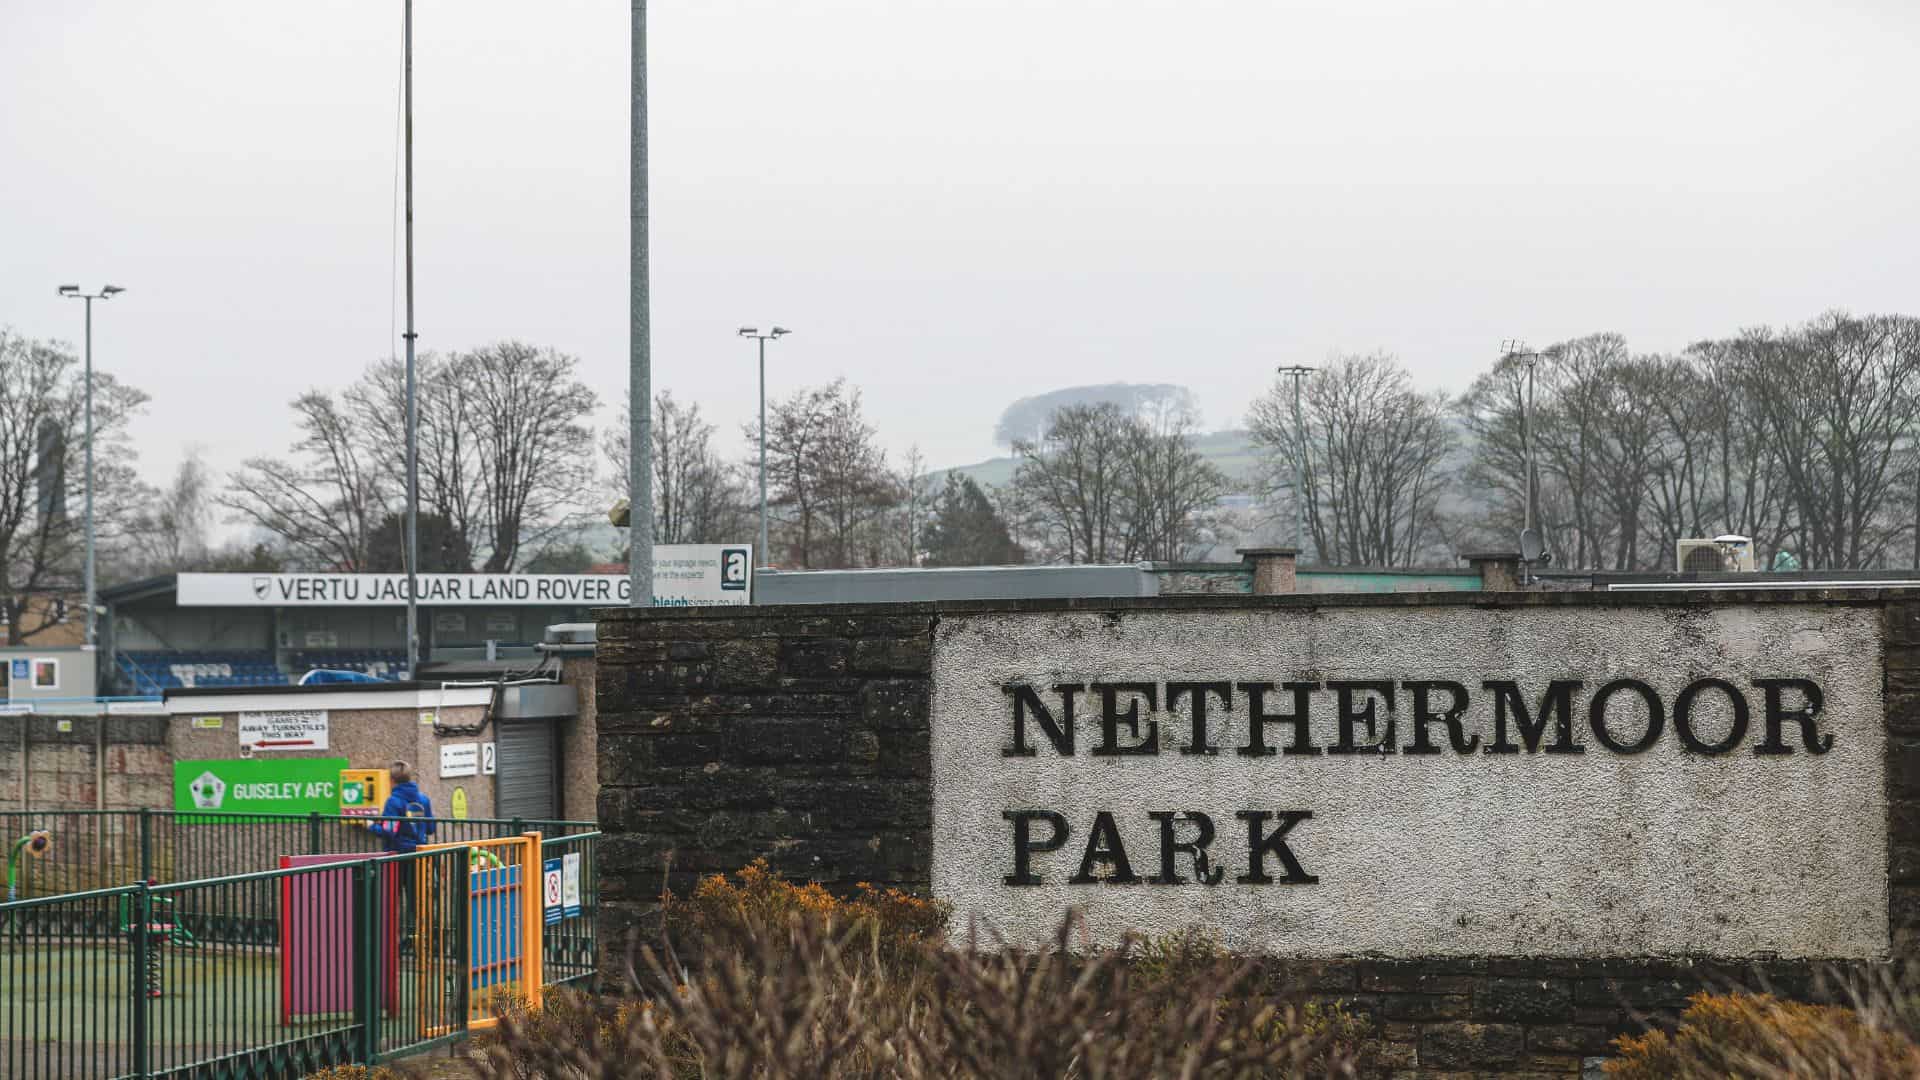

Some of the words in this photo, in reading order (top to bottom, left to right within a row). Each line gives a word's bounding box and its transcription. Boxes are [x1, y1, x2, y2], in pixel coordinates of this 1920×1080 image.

[278, 578, 359, 600] VERTU
[469, 578, 529, 600] LAND
[537, 578, 611, 600] ROVER
[1001, 678, 1834, 756] NETHERMOOR
[485, 745, 494, 771] 2
[233, 782, 302, 800] GUISELEY
[304, 781, 334, 799] AFC
[1003, 810, 1319, 885] PARK
